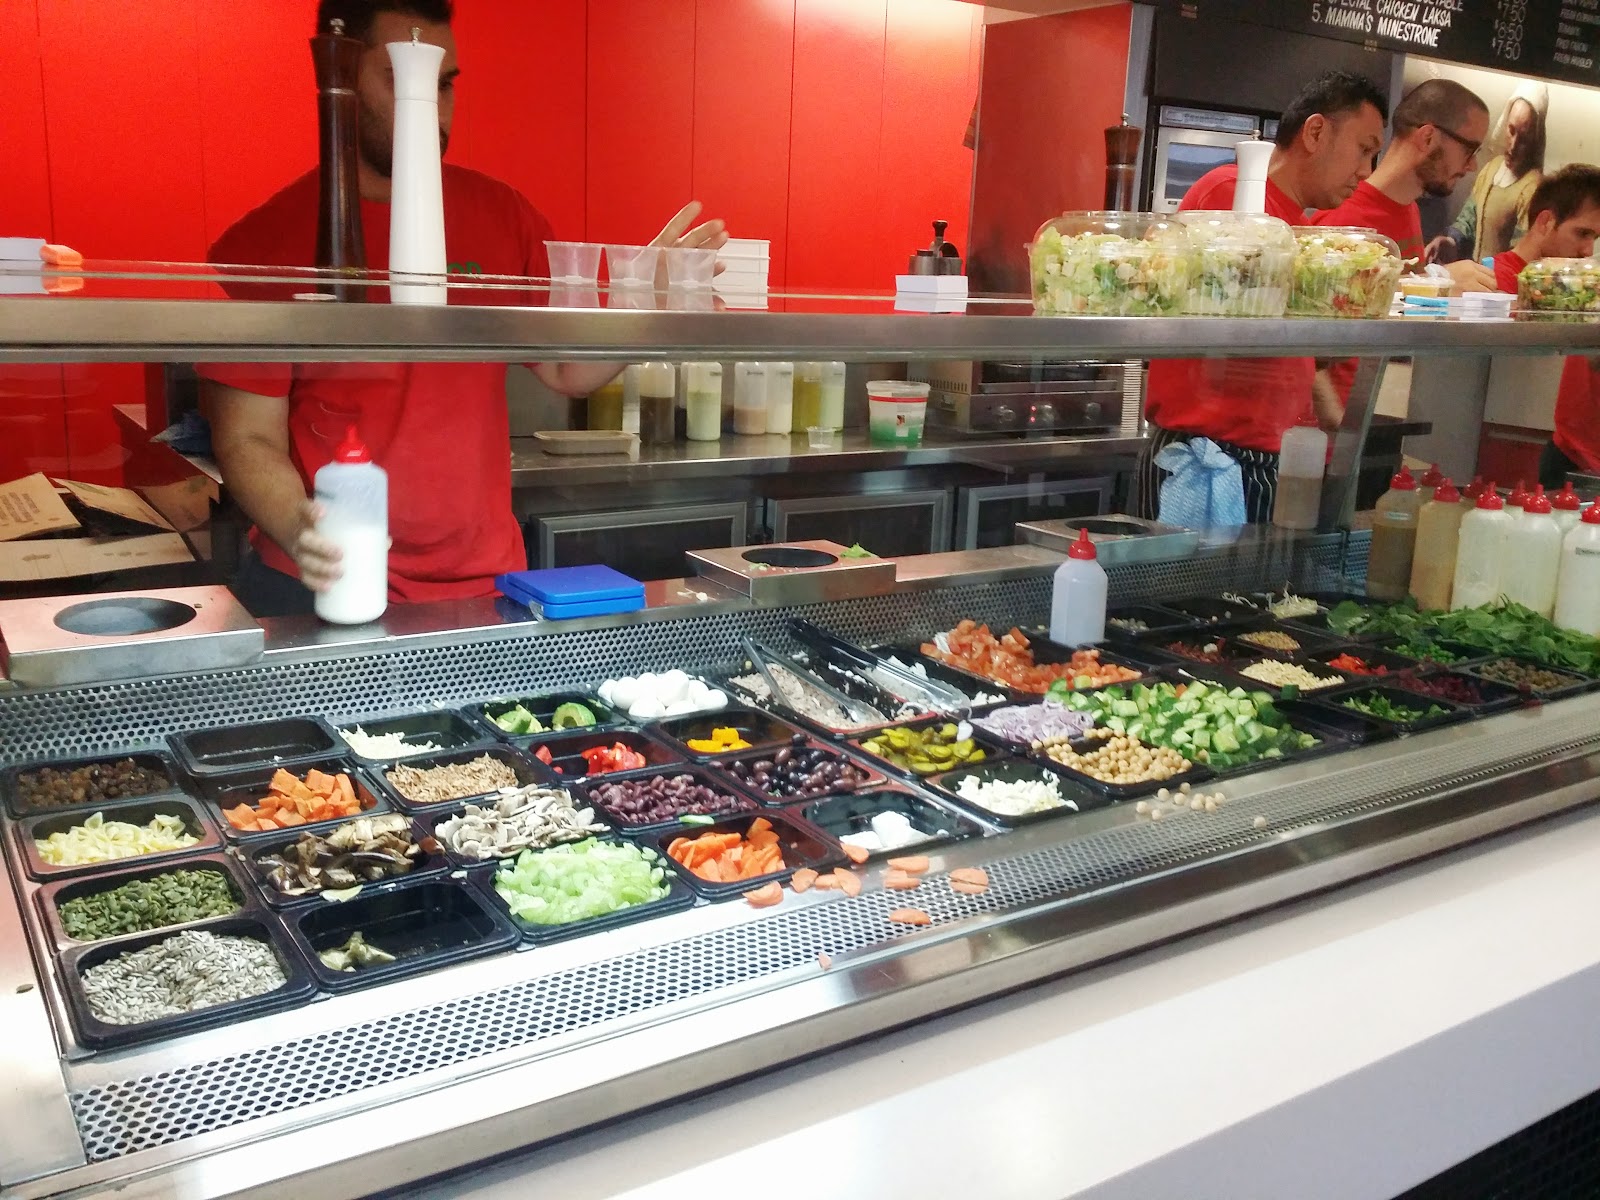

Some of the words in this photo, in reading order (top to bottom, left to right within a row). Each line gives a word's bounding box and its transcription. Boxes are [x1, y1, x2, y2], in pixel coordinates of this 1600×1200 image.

[1311, 3, 1323, 23] 5.
[1325, 6, 1374, 32] MAMMA'S
[1377, 16, 1441, 47] MINESTRONE
[1376, 0, 1421, 21] CHICKEN
[1422, 6, 1451, 27] LAKSA
